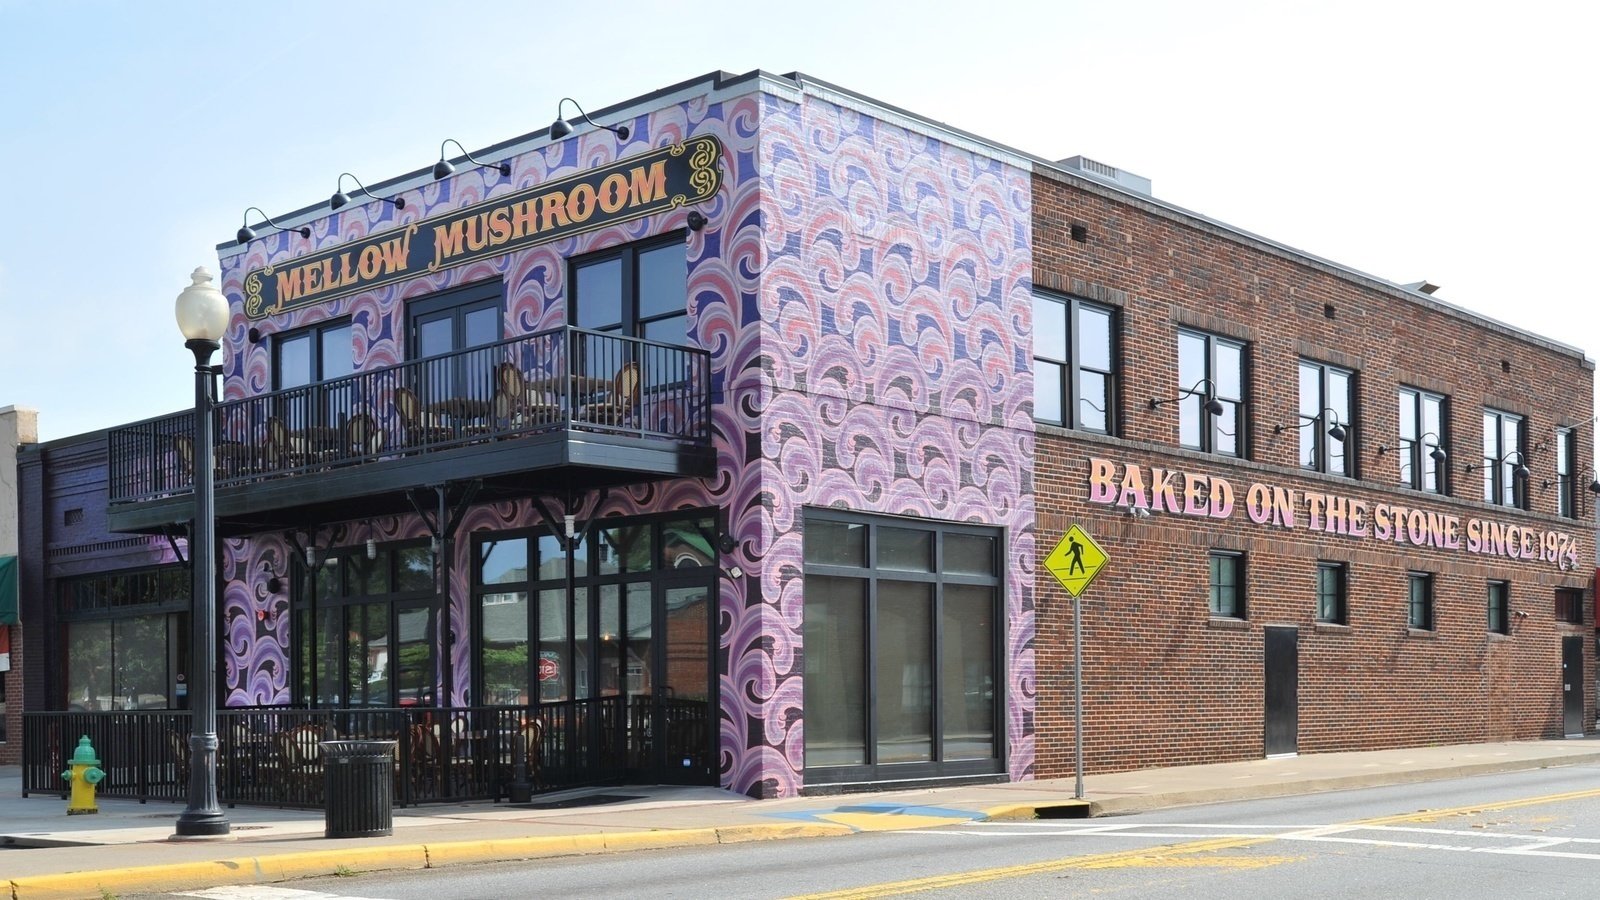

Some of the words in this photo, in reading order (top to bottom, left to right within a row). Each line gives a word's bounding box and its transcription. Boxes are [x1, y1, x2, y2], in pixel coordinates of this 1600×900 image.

[272, 224, 418, 315] MELLOW
[428, 159, 669, 273] MUSHROOM
[1088, 457, 1235, 520] BAKED
[1246, 482, 1295, 529] ON
[1304, 492, 1368, 538] THE
[1374, 503, 1460, 551] STONE
[1466, 518, 1535, 560] SINCE
[1538, 530, 1579, 571] 1974
